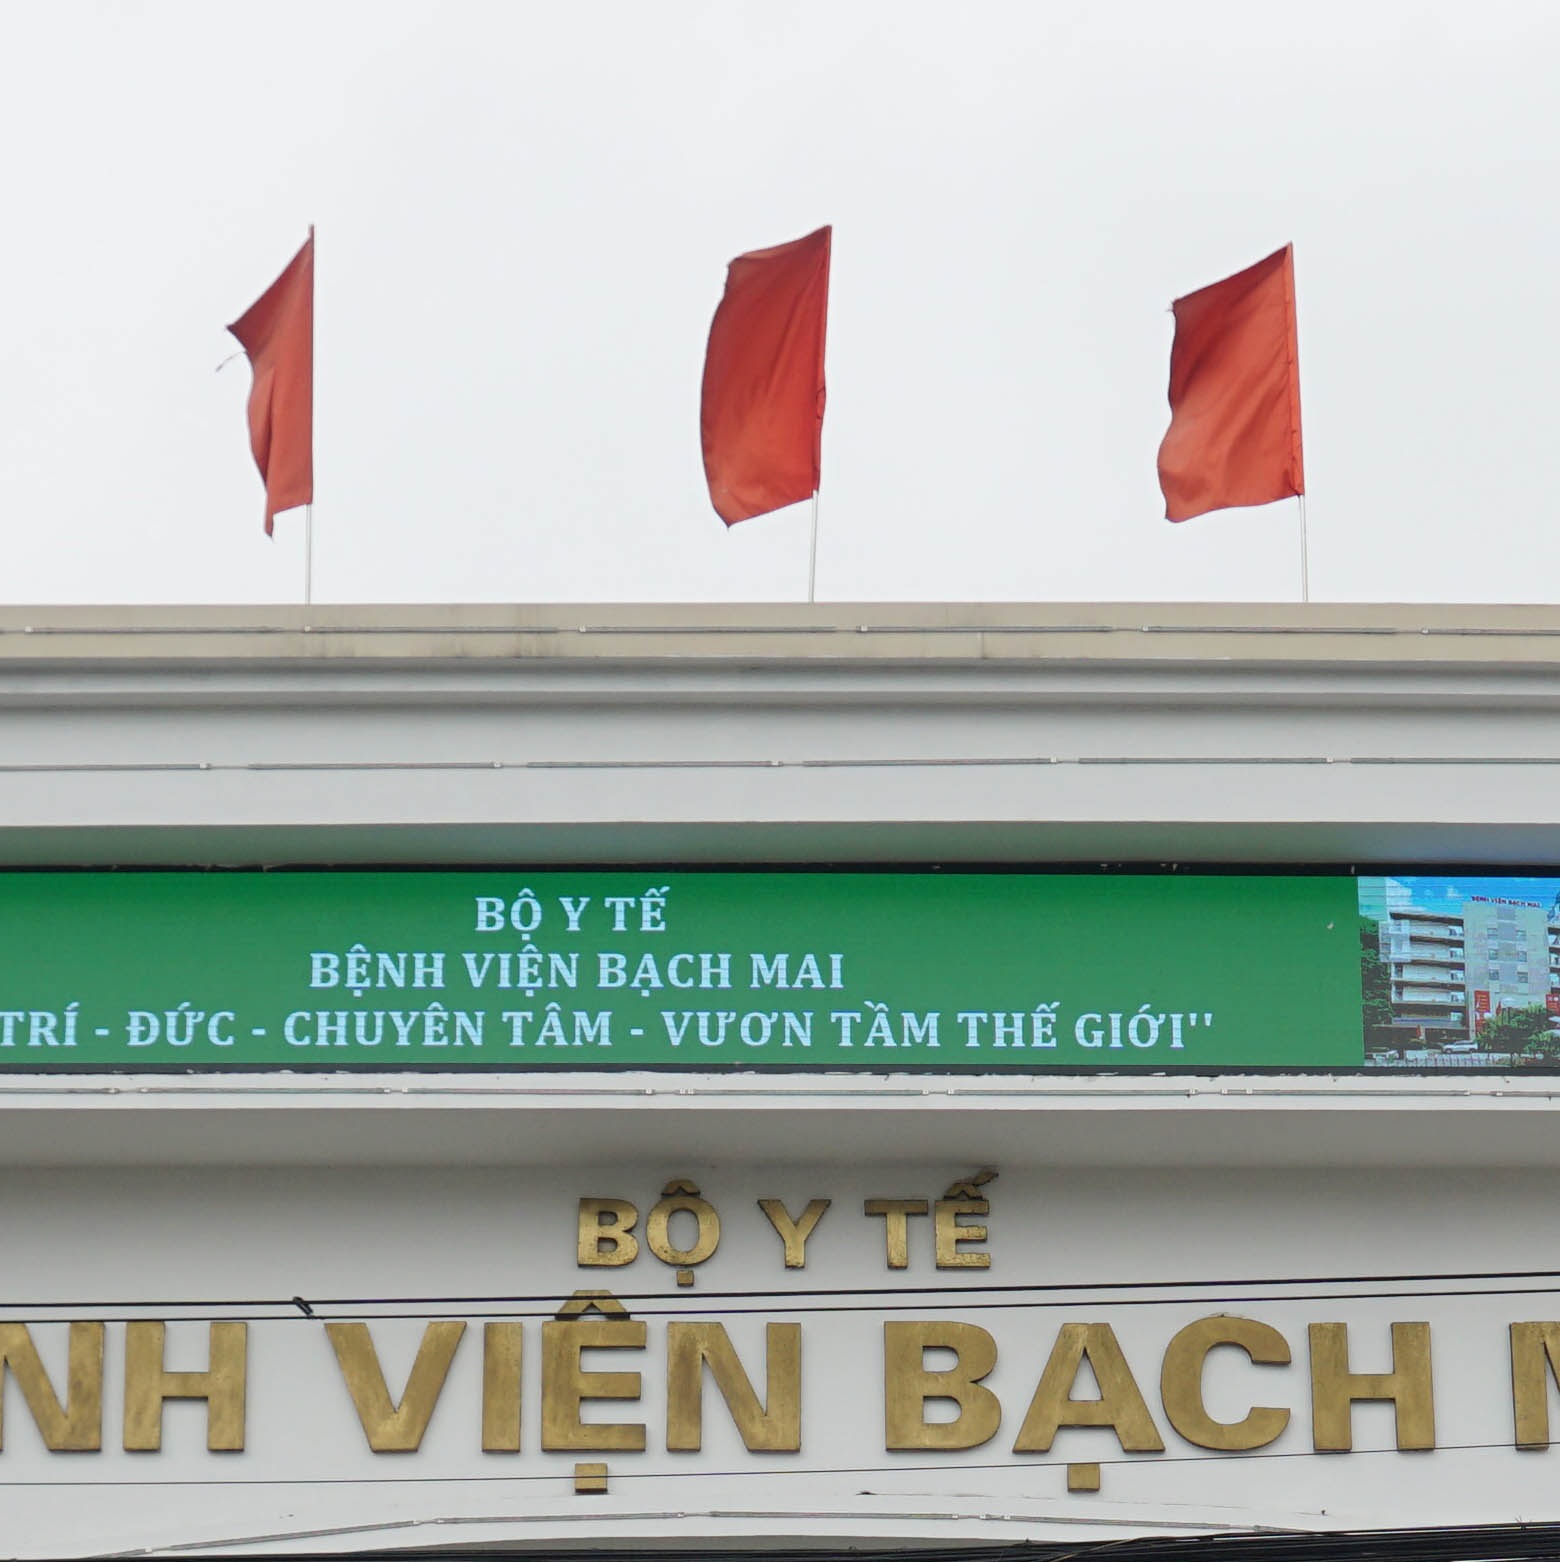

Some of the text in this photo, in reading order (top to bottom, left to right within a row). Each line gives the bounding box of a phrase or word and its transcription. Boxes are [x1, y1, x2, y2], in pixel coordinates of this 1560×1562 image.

[475, 886, 671, 941] BỘ Y TẾ
[309, 943, 845, 997] BỆNH VIỆN BẠCH MAI
[126, 1001, 236, 1047] ĐỨC
[283, 1001, 485, 1047] CHUYÊN
[502, 1001, 613, 1047] TÂM
[661, 1008, 815, 1047] VƯƠN
[830, 1000, 941, 1047] TẦM
[957, 1000, 1061, 1048] THẾ
[577, 1165, 1000, 1287] BỘ Y TẾ
[324, 1289, 803, 1494] VIỆN
[882, 1313, 1437, 1493] BẠCH
